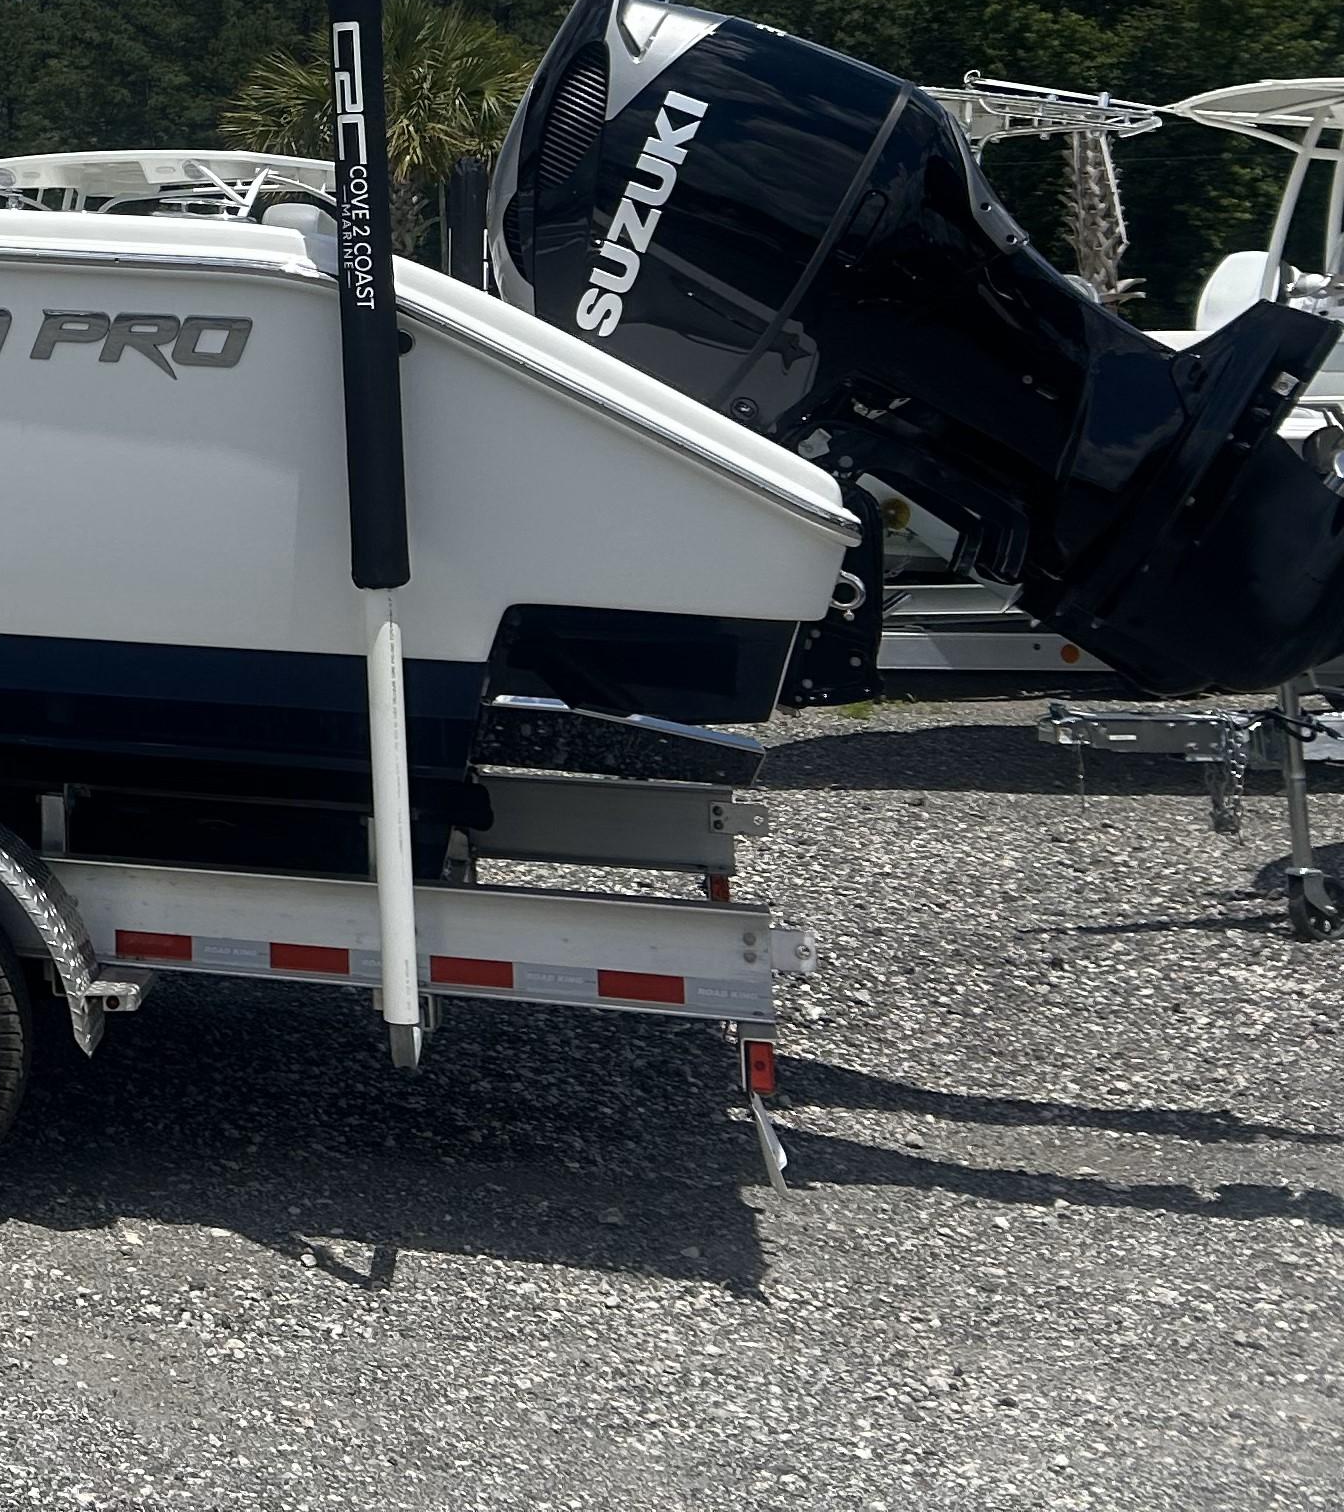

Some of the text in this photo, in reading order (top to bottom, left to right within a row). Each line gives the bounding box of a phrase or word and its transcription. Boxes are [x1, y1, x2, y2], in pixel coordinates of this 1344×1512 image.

[340, 203, 354, 269] MARINE
[349, 165, 375, 310] COVE 2 COAST
[575, 90, 709, 338] SUZUKI
[29, 307, 253, 381] PRO
